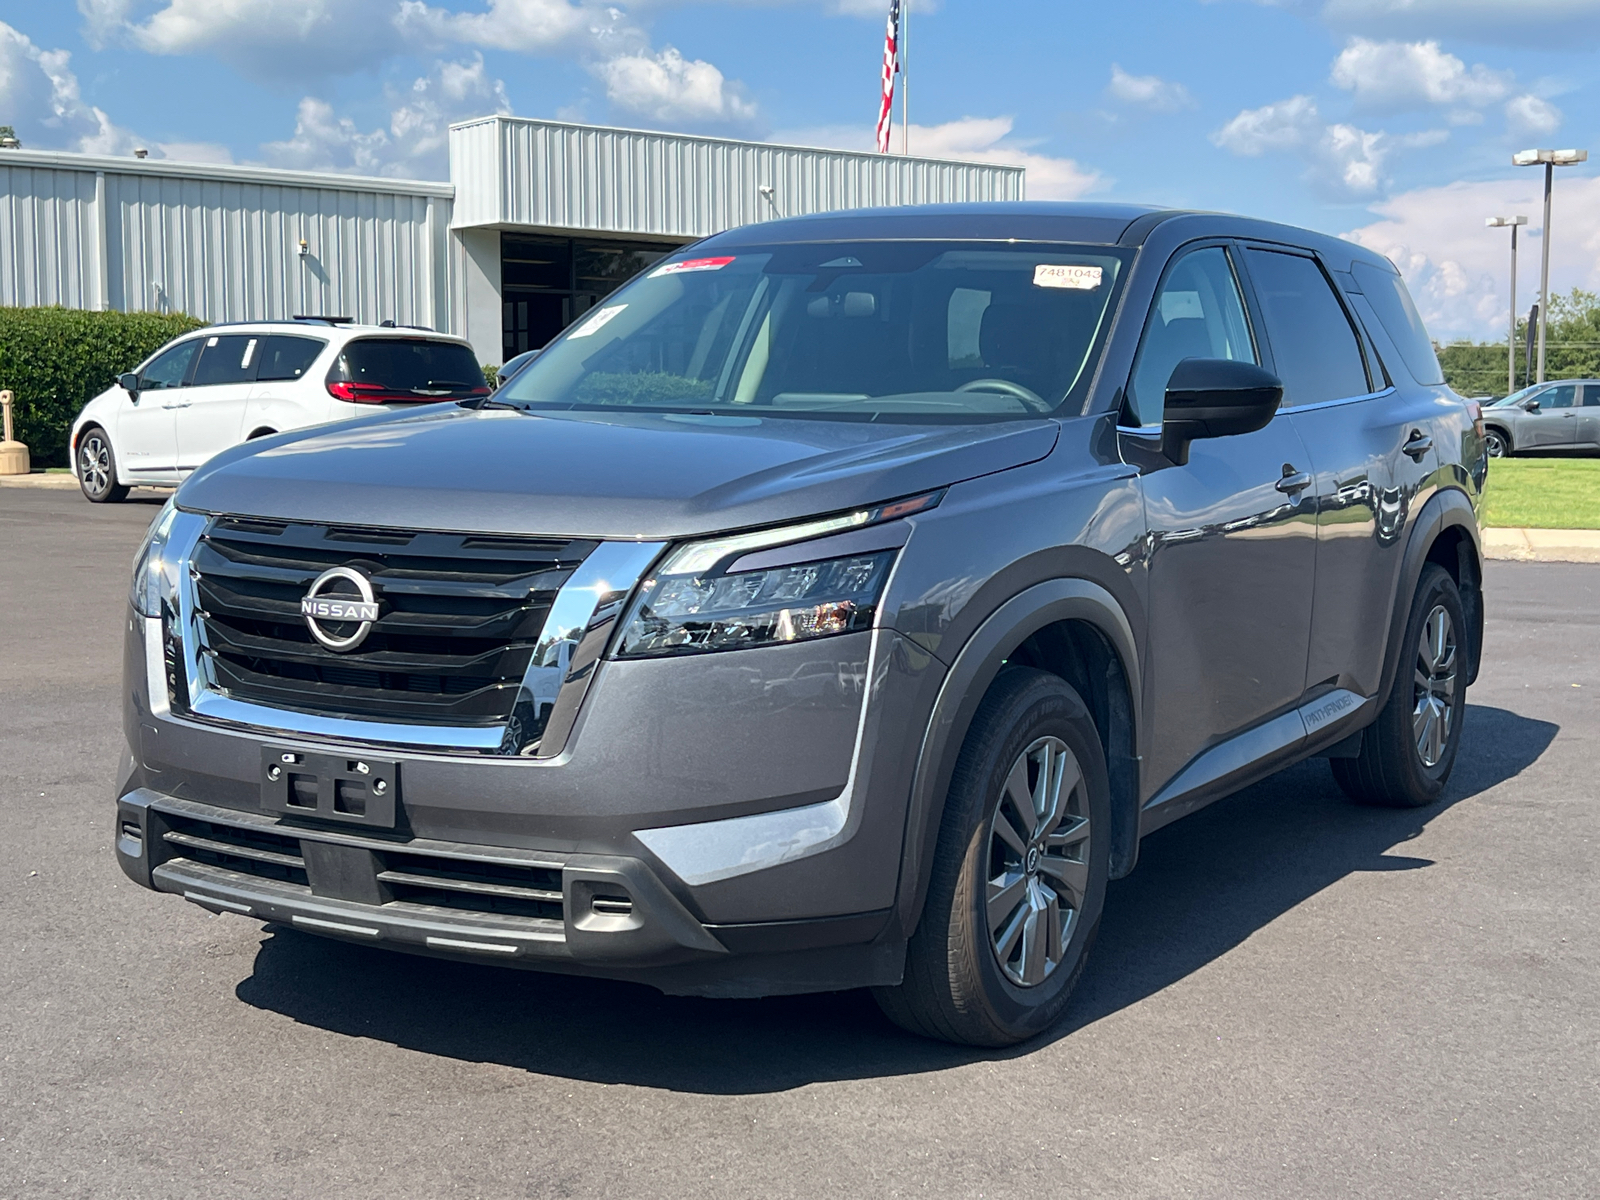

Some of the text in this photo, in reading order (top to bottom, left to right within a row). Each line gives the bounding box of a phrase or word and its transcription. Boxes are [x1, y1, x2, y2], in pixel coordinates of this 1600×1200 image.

[1039, 268, 1101, 279] 7481043
[301, 600, 376, 619] NISSAN
[1305, 694, 1354, 727] PATHFINDER
